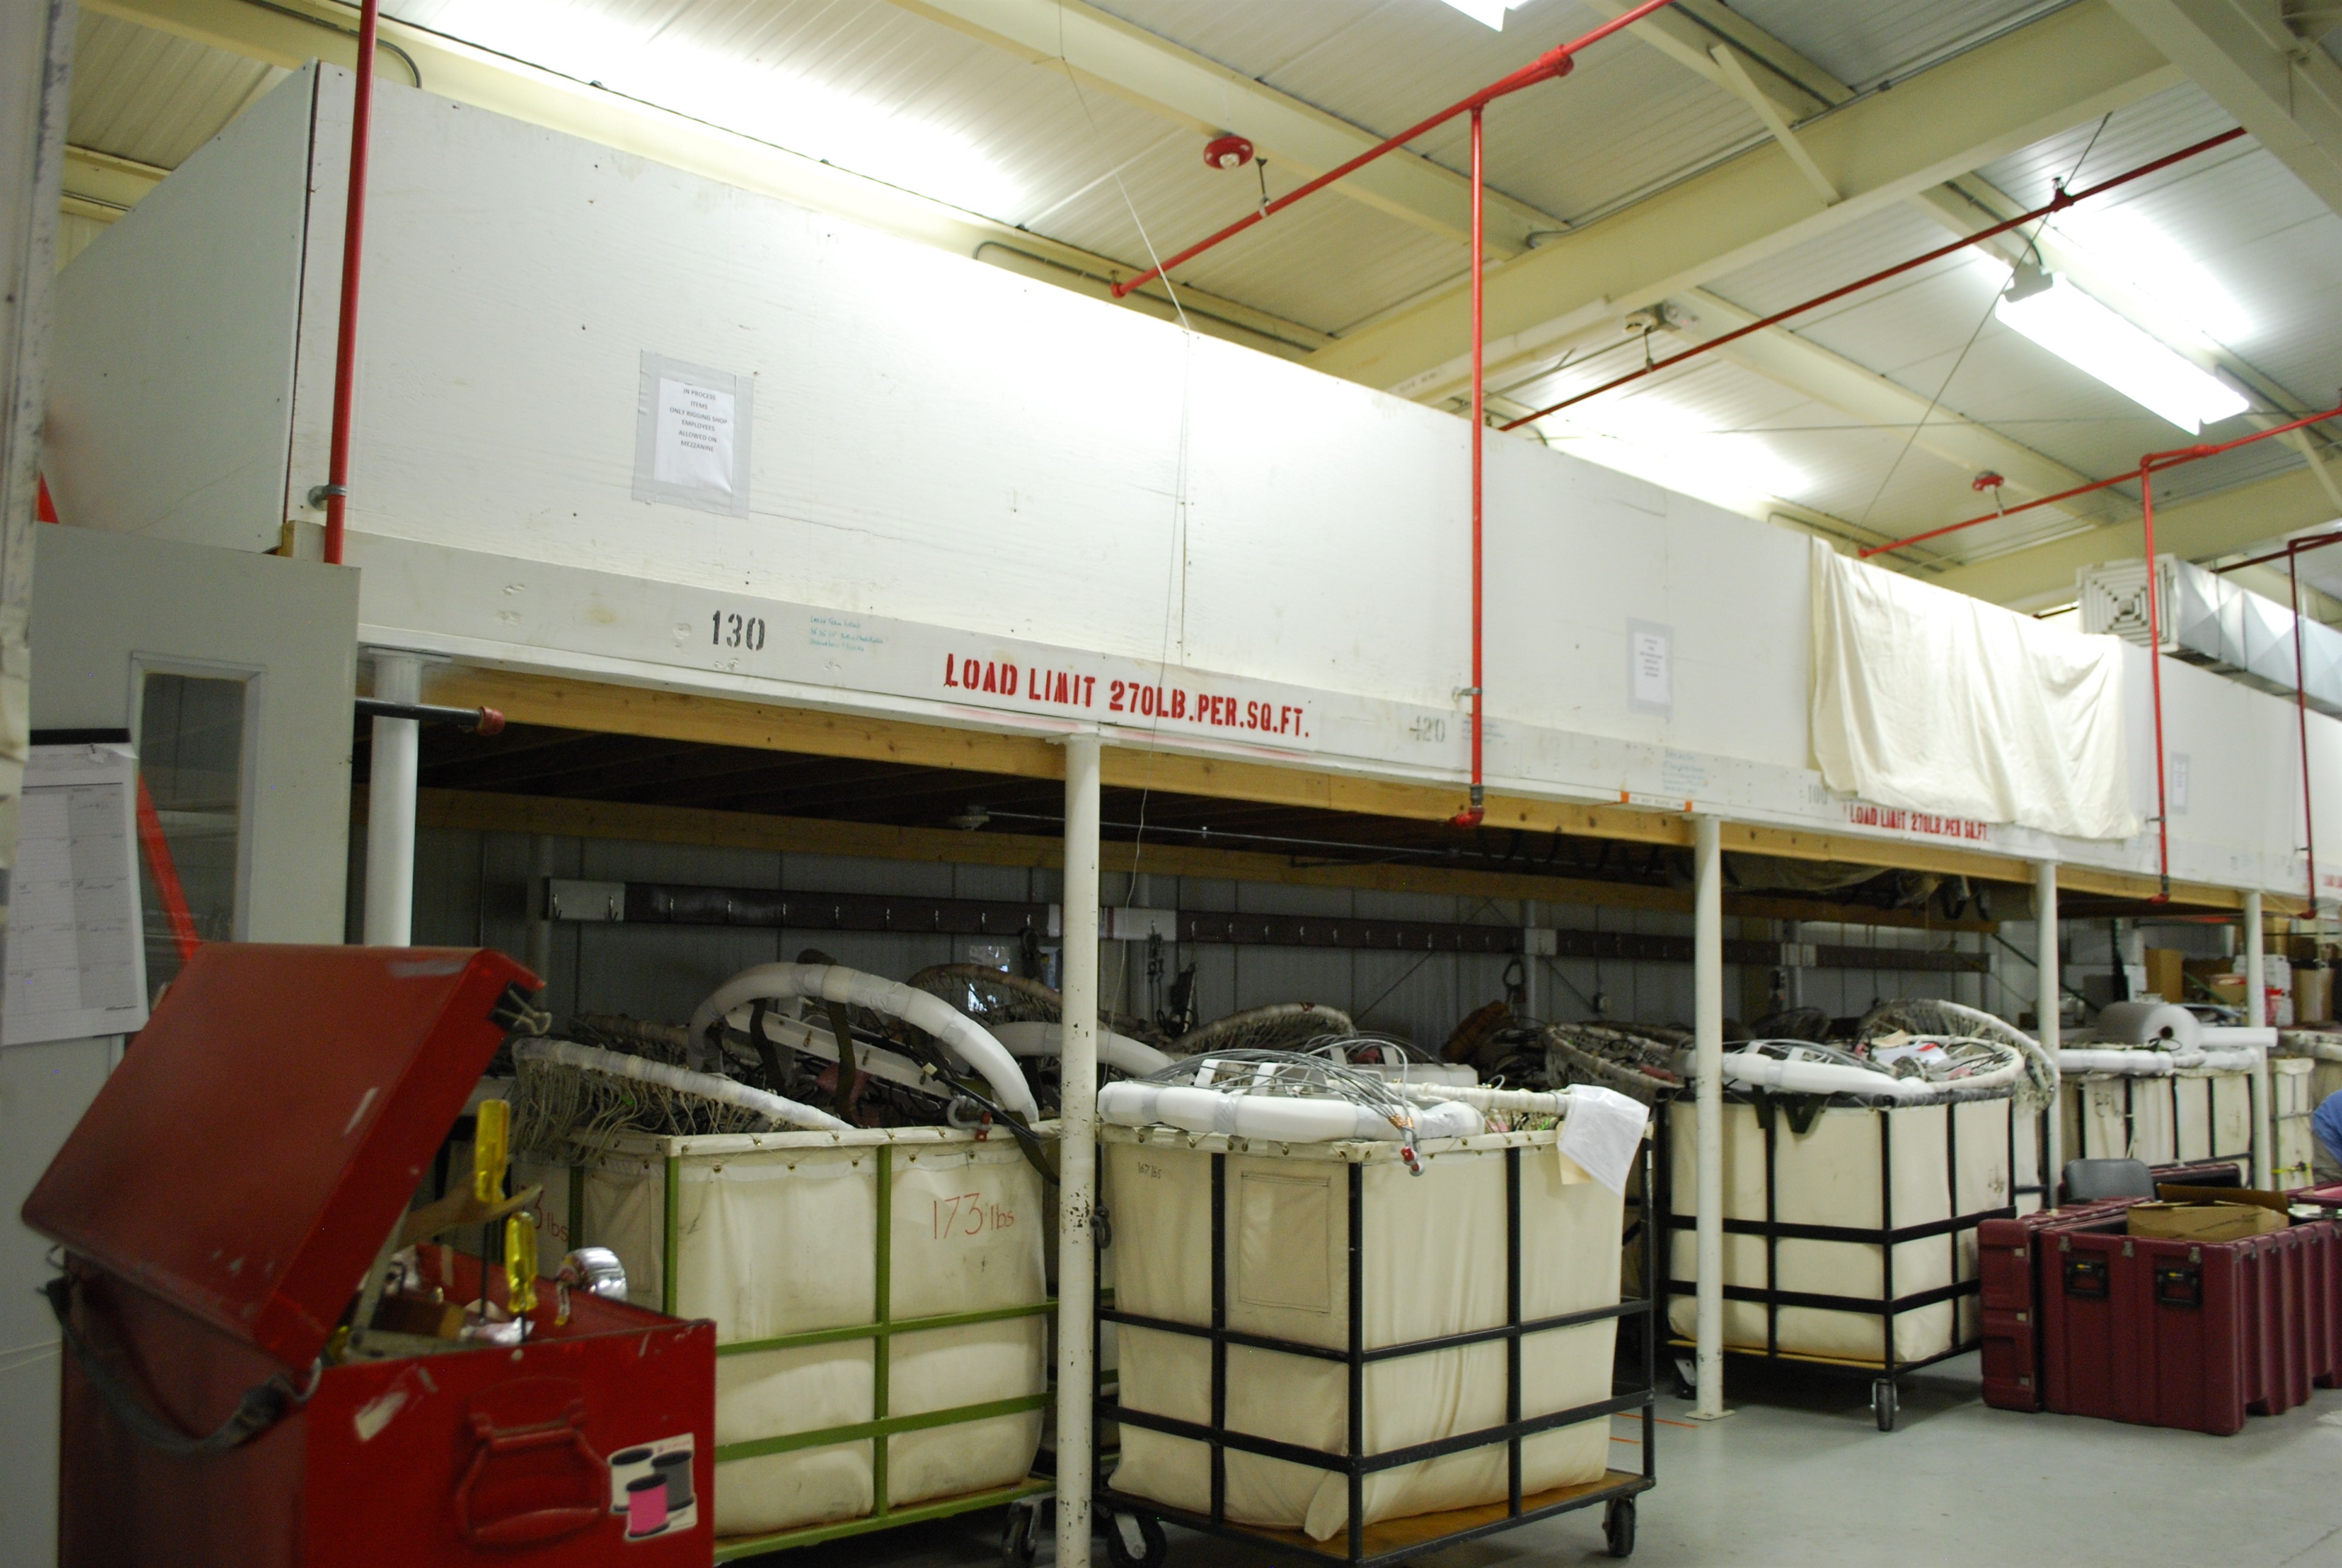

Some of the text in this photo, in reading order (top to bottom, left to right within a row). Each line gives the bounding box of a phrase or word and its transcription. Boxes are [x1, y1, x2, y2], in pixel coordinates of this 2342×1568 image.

[691, 390, 715, 400] PROCESS
[690, 401, 707, 409] ITEMS
[687, 410, 710, 421] RIGGING
[682, 420, 714, 431] EMPLOYEES
[679, 430, 706, 440] ALLOWED
[681, 440, 713, 451] MEZZANINE
[712, 610, 765, 651] 130
[945, 654, 1017, 696] LOAD
[1029, 668, 1095, 707] LIMIT
[1851, 804, 1877, 825] LOAD
[1881, 810, 1905, 829] LIMIT
[934, 1193, 1014, 1239] 173 lbs
